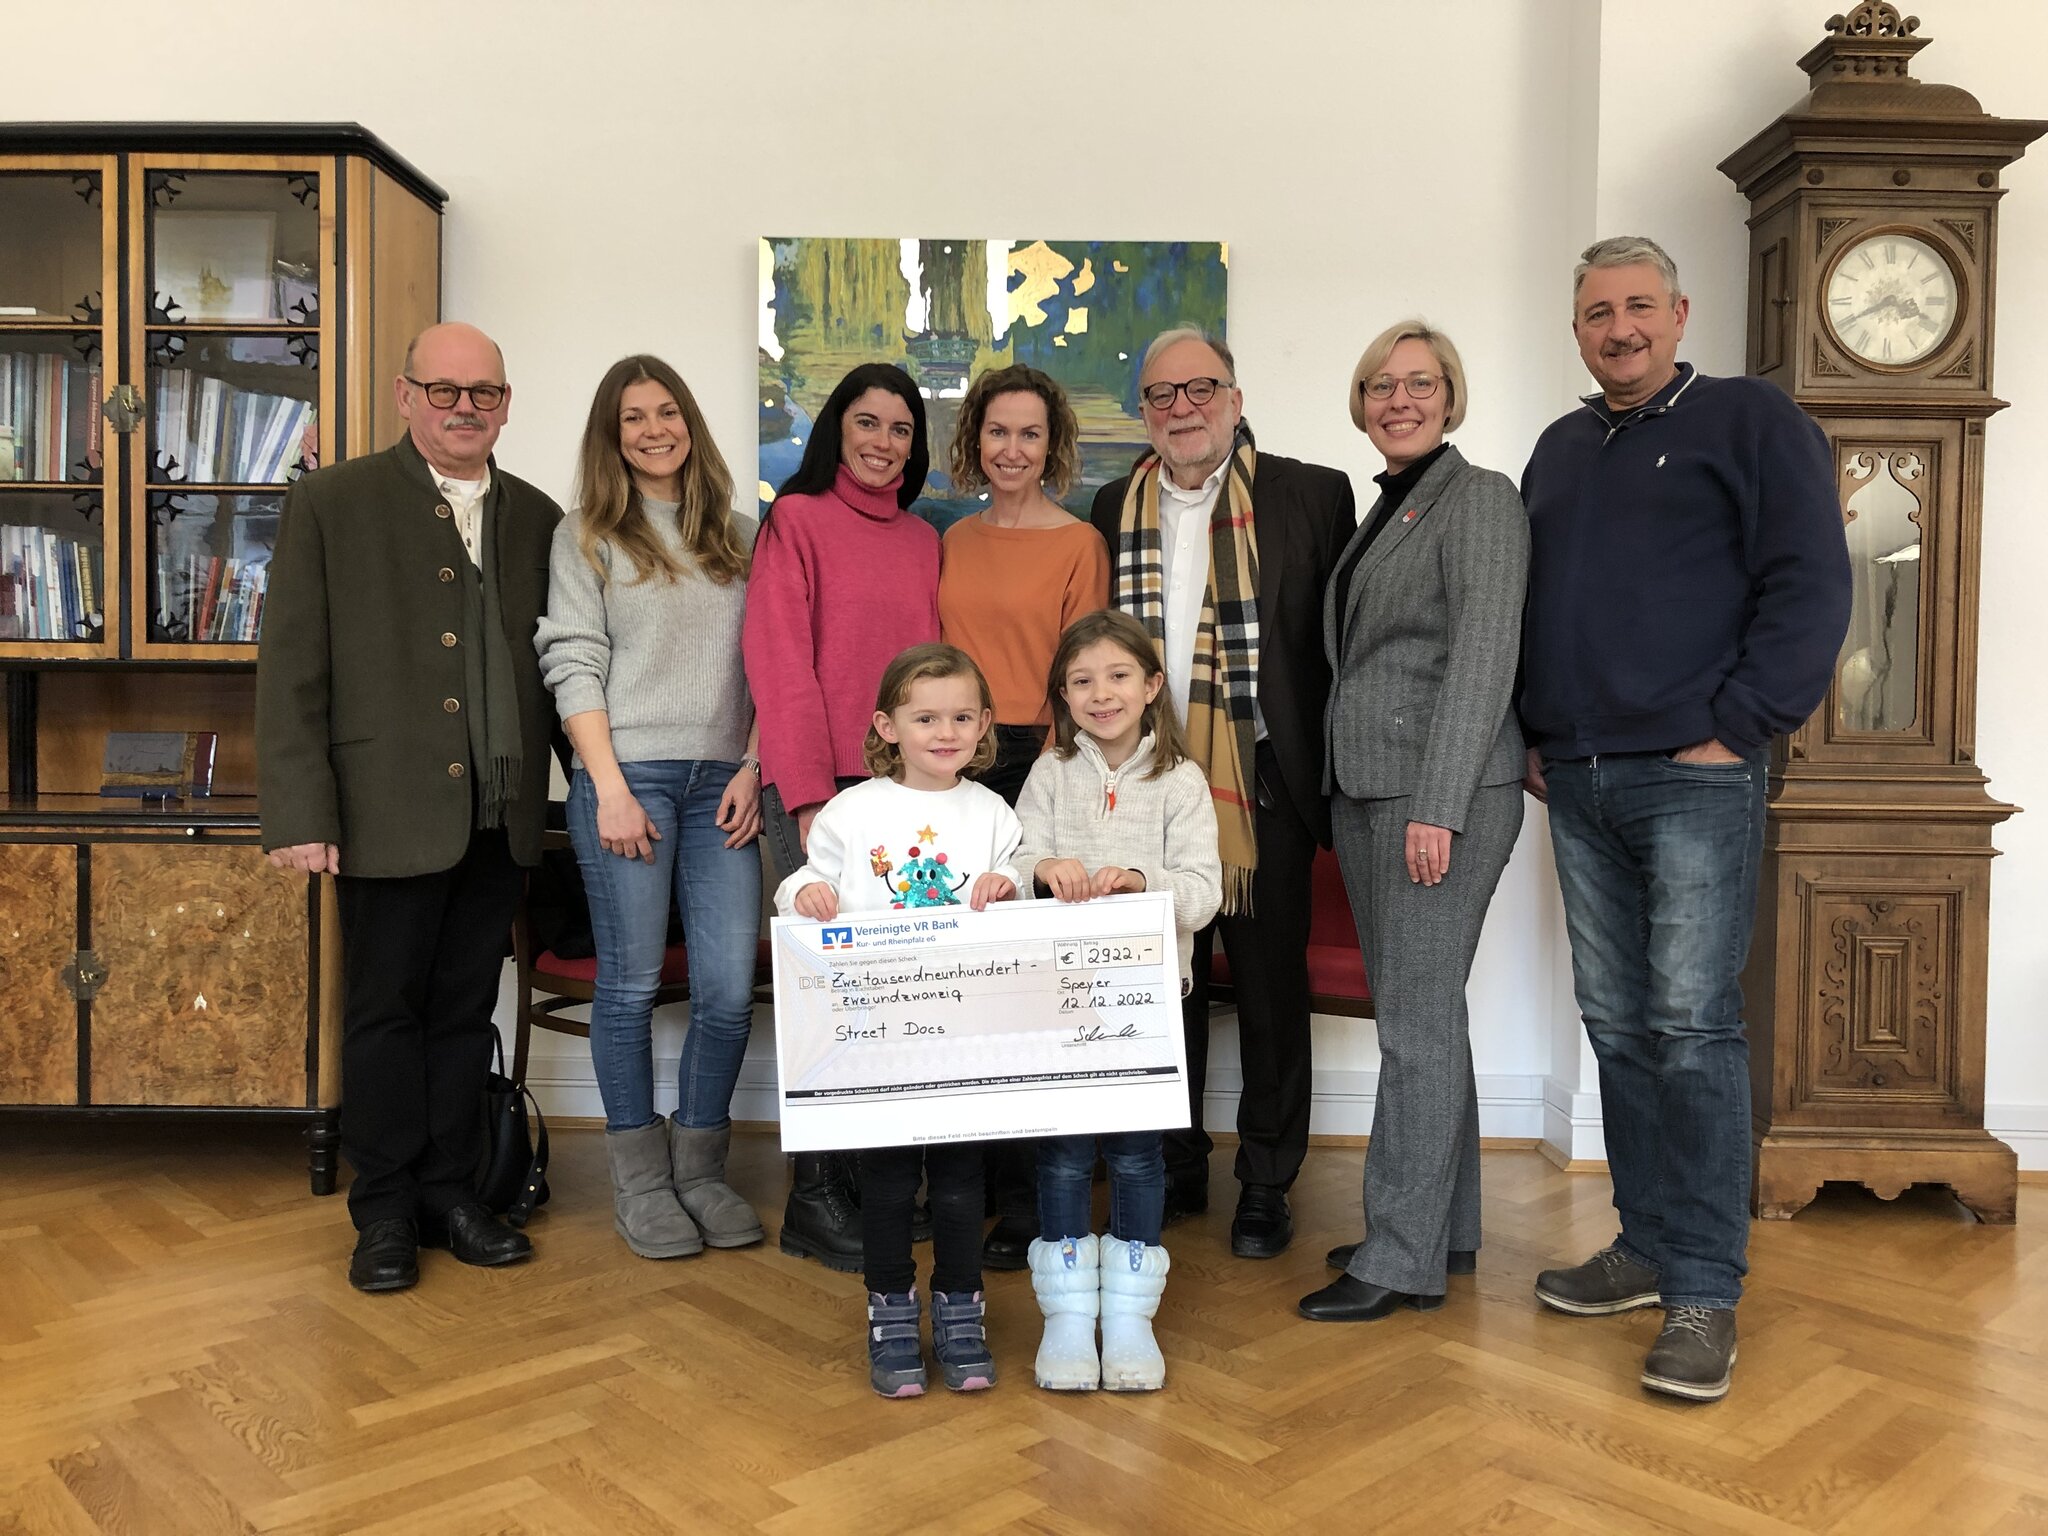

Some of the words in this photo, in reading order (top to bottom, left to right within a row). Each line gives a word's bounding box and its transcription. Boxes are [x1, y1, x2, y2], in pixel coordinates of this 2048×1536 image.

[855, 922, 911, 937] Vereinigte
[914, 921, 929, 931] VR
[932, 918, 959, 930] Bank
[856, 940, 871, 948] Kur-
[872, 938, 887, 947] und
[888, 936, 925, 946] Rheinpfalz
[926, 935, 936, 943] eG
[850, 959, 858, 967] Sie
[859, 959, 878, 967] gegen
[1060, 951, 1075, 965] €
[798, 975, 827, 990] DE
[1060, 976, 1111, 995] Speyer
[1117, 992, 1154, 1007] 2022
[834, 1022, 887, 1041] Street
[903, 1021, 945, 1036] Docs
